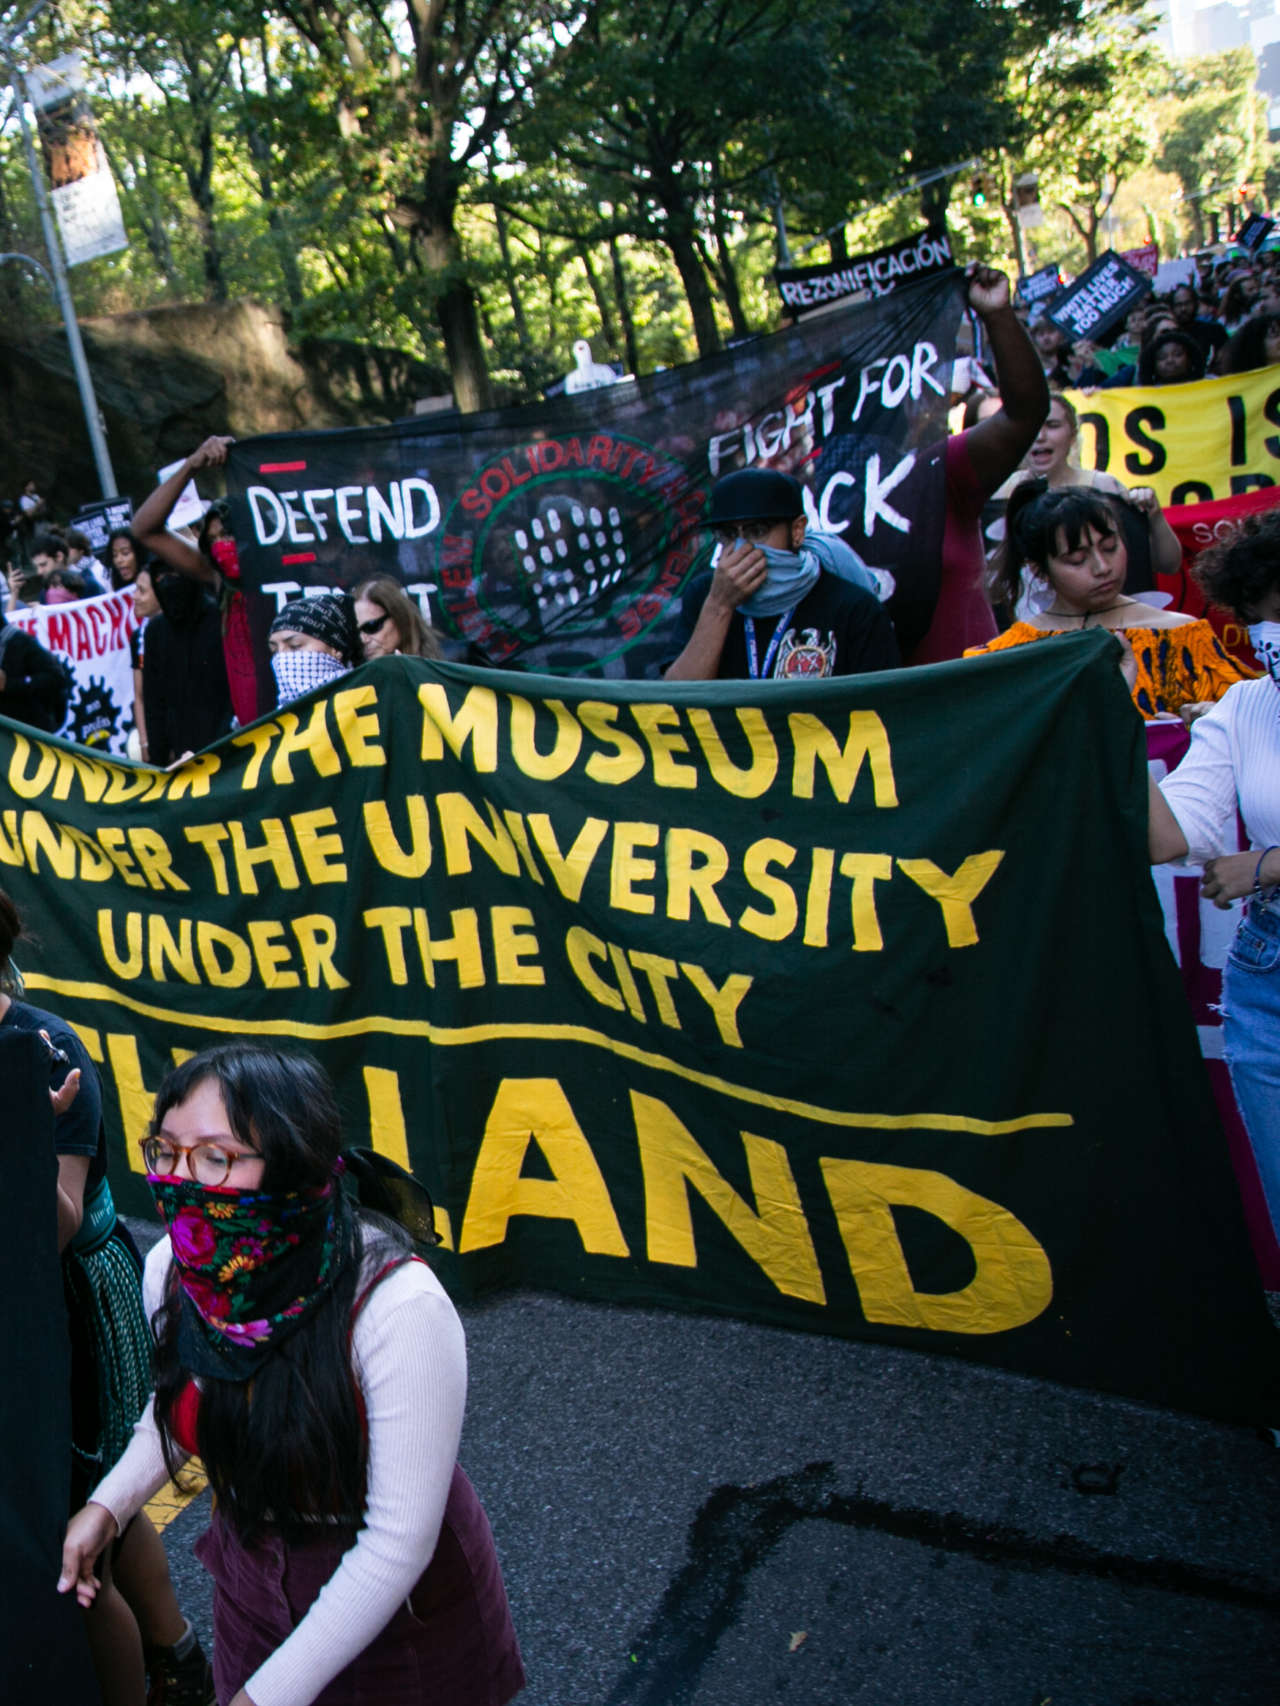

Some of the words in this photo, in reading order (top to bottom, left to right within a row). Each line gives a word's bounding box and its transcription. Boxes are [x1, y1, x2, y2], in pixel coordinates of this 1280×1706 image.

[1072, 308, 1100, 335] TOO
[1097, 276, 1135, 313] MUCH
[1086, 260, 1119, 291] LIVES
[708, 376, 846, 477] FIGHT
[852, 341, 946, 422] FOR
[247, 477, 441, 546] DEFEND
[460, 435, 669, 520] SOLIDARITY
[8, 733, 220, 804] UNDER
[232, 685, 387, 790] THE
[418, 683, 899, 808] MUSEUM
[184, 806, 348, 896] THE
[363, 792, 1006, 952] UNIVERSITY
[98, 909, 350, 990] UNDER
[364, 906, 545, 989] THE
[565, 925, 753, 1048] CITY
